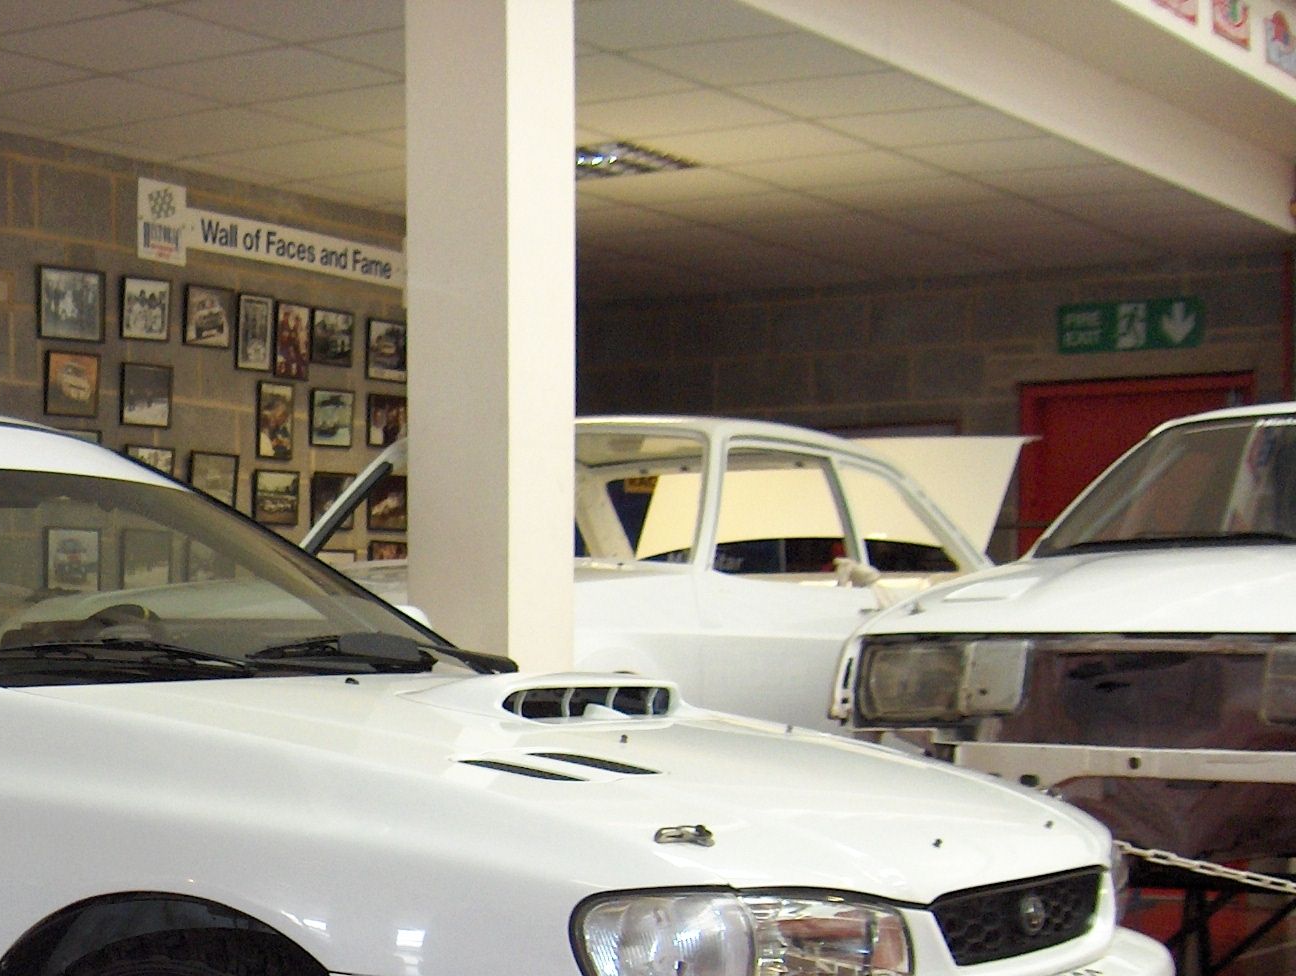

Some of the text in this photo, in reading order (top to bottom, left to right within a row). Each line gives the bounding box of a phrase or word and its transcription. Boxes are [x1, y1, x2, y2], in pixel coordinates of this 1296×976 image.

[200, 218, 238, 248] Wall
[242, 228, 262, 251] of
[266, 231, 316, 264] Faces
[319, 246, 348, 270] and
[352, 248, 393, 280] Fame
